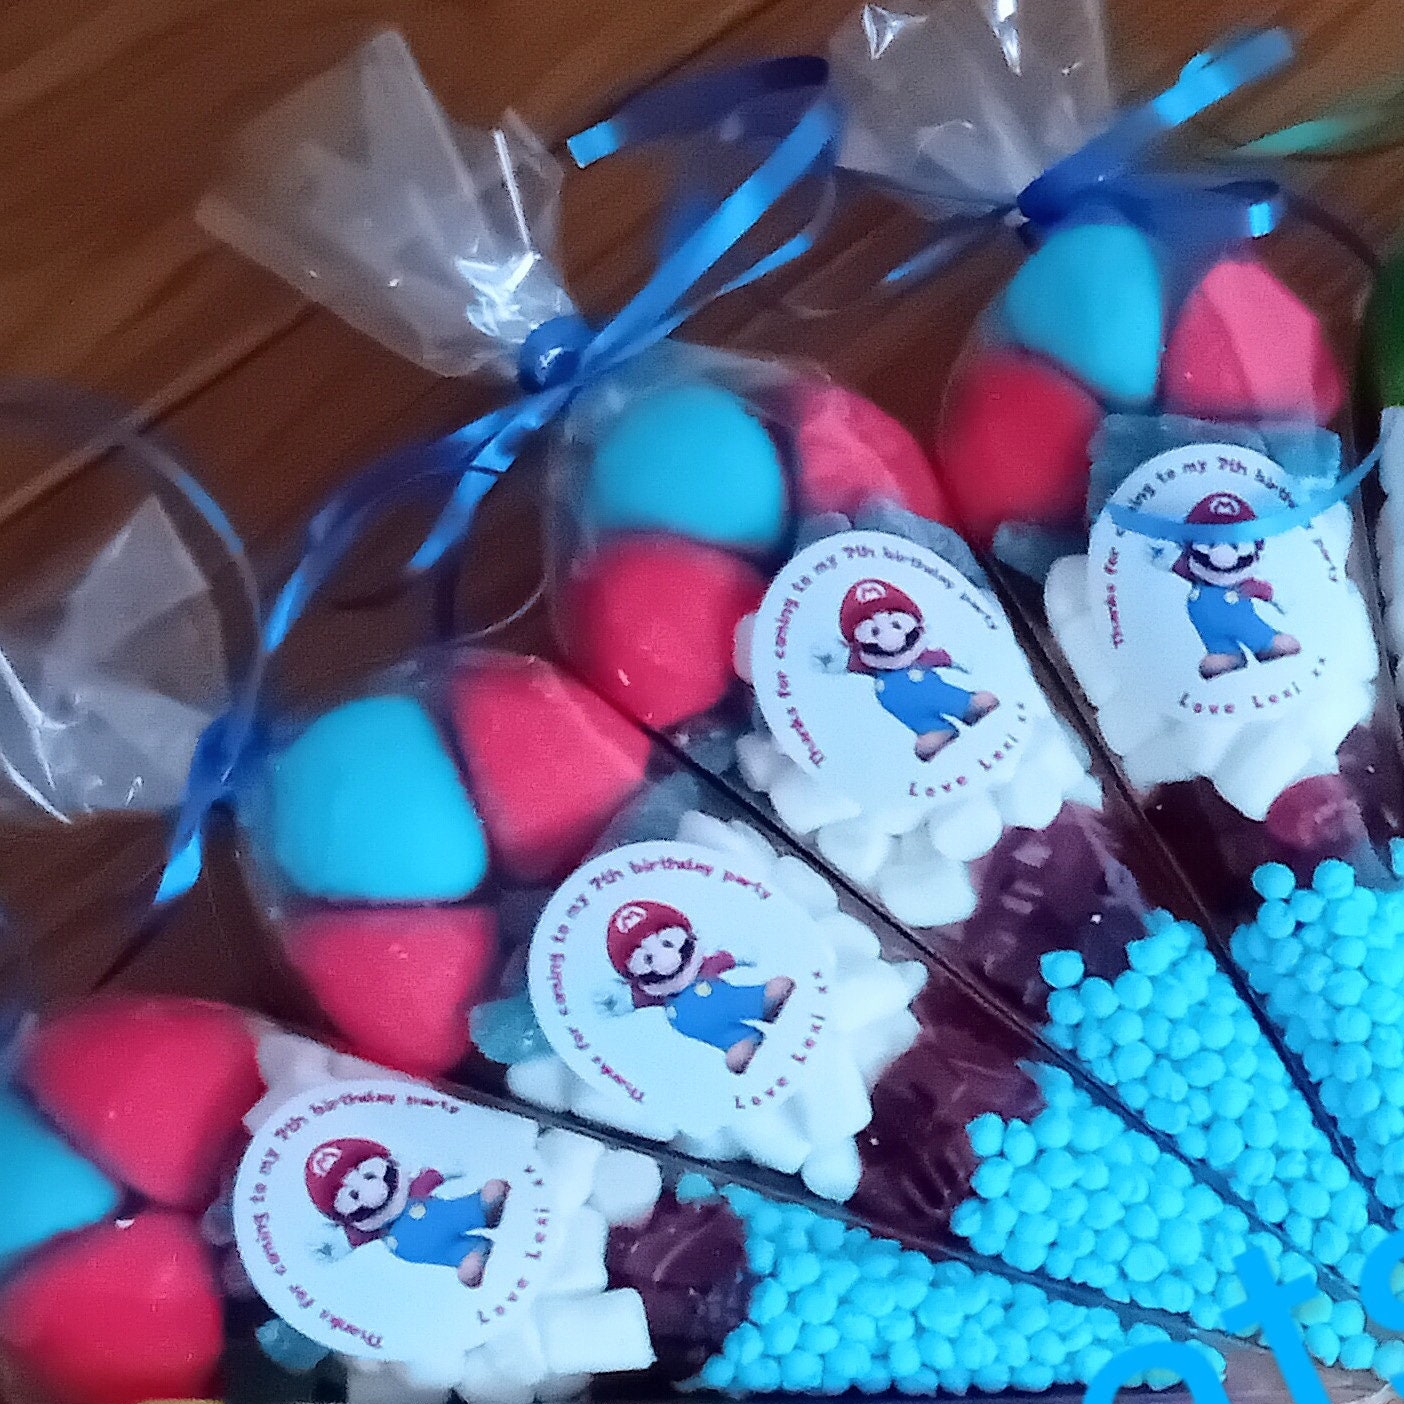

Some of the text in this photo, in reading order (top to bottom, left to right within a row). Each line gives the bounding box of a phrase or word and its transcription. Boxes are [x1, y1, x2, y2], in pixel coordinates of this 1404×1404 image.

[1178, 691, 1235, 713] Love
[909, 777, 966, 797] Love
[552, 924, 569, 943] to
[567, 893, 589, 916] my
[629, 857, 714, 875] birthday
[735, 1077, 789, 1109] Love
[250, 1183, 267, 1202] to
[477, 1278, 528, 1323] Love
